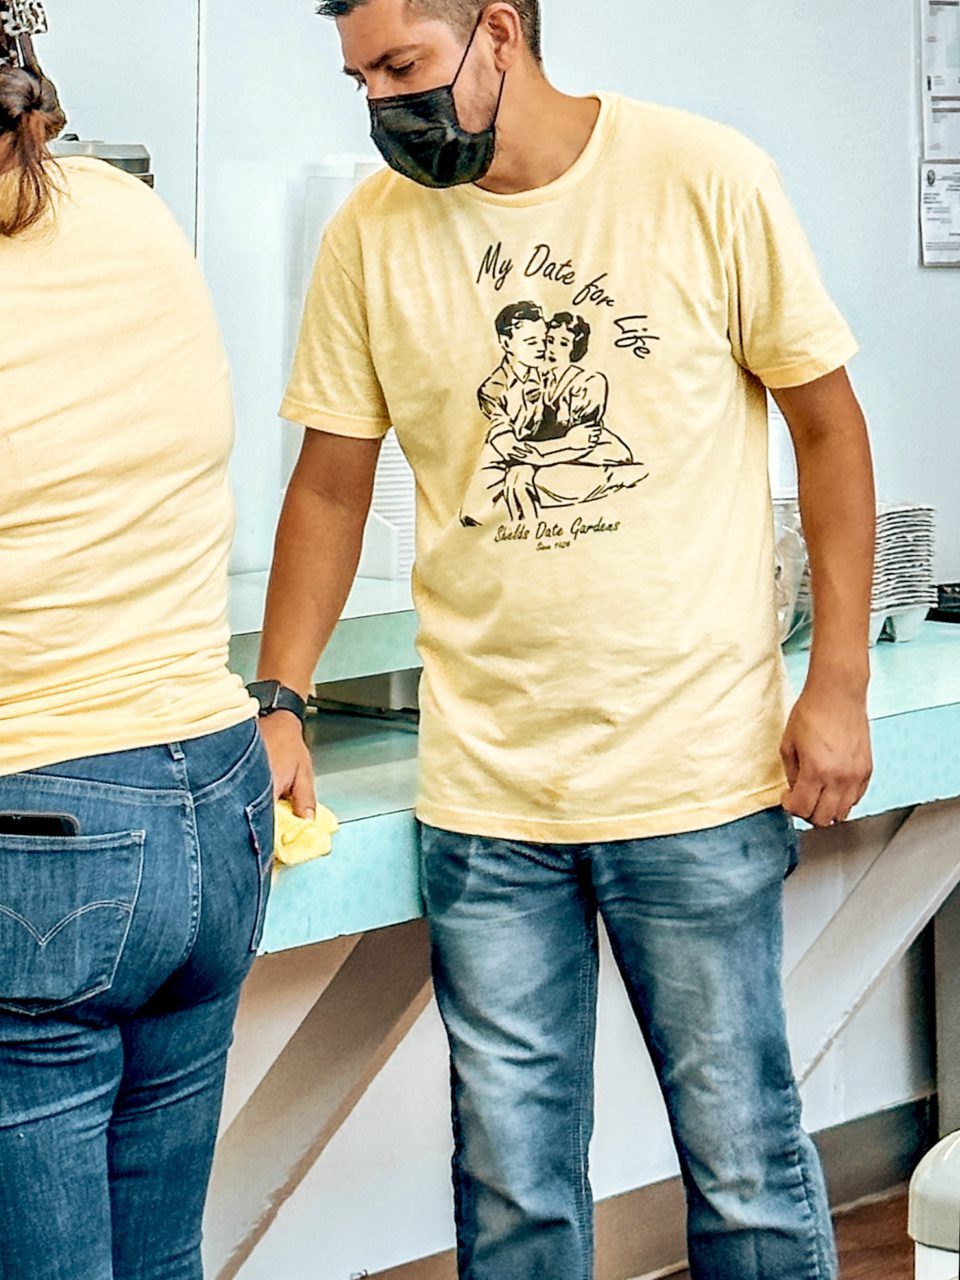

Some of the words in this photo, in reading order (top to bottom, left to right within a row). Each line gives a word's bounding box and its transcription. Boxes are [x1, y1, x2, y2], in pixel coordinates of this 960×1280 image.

[476, 240, 514, 292] My
[523, 243, 576, 286] Date
[572, 272, 616, 308] for
[613, 314, 661, 360] Life
[494, 523, 530, 543] Shields
[535, 520, 564, 541] Date
[570, 516, 621, 541] Gardens
